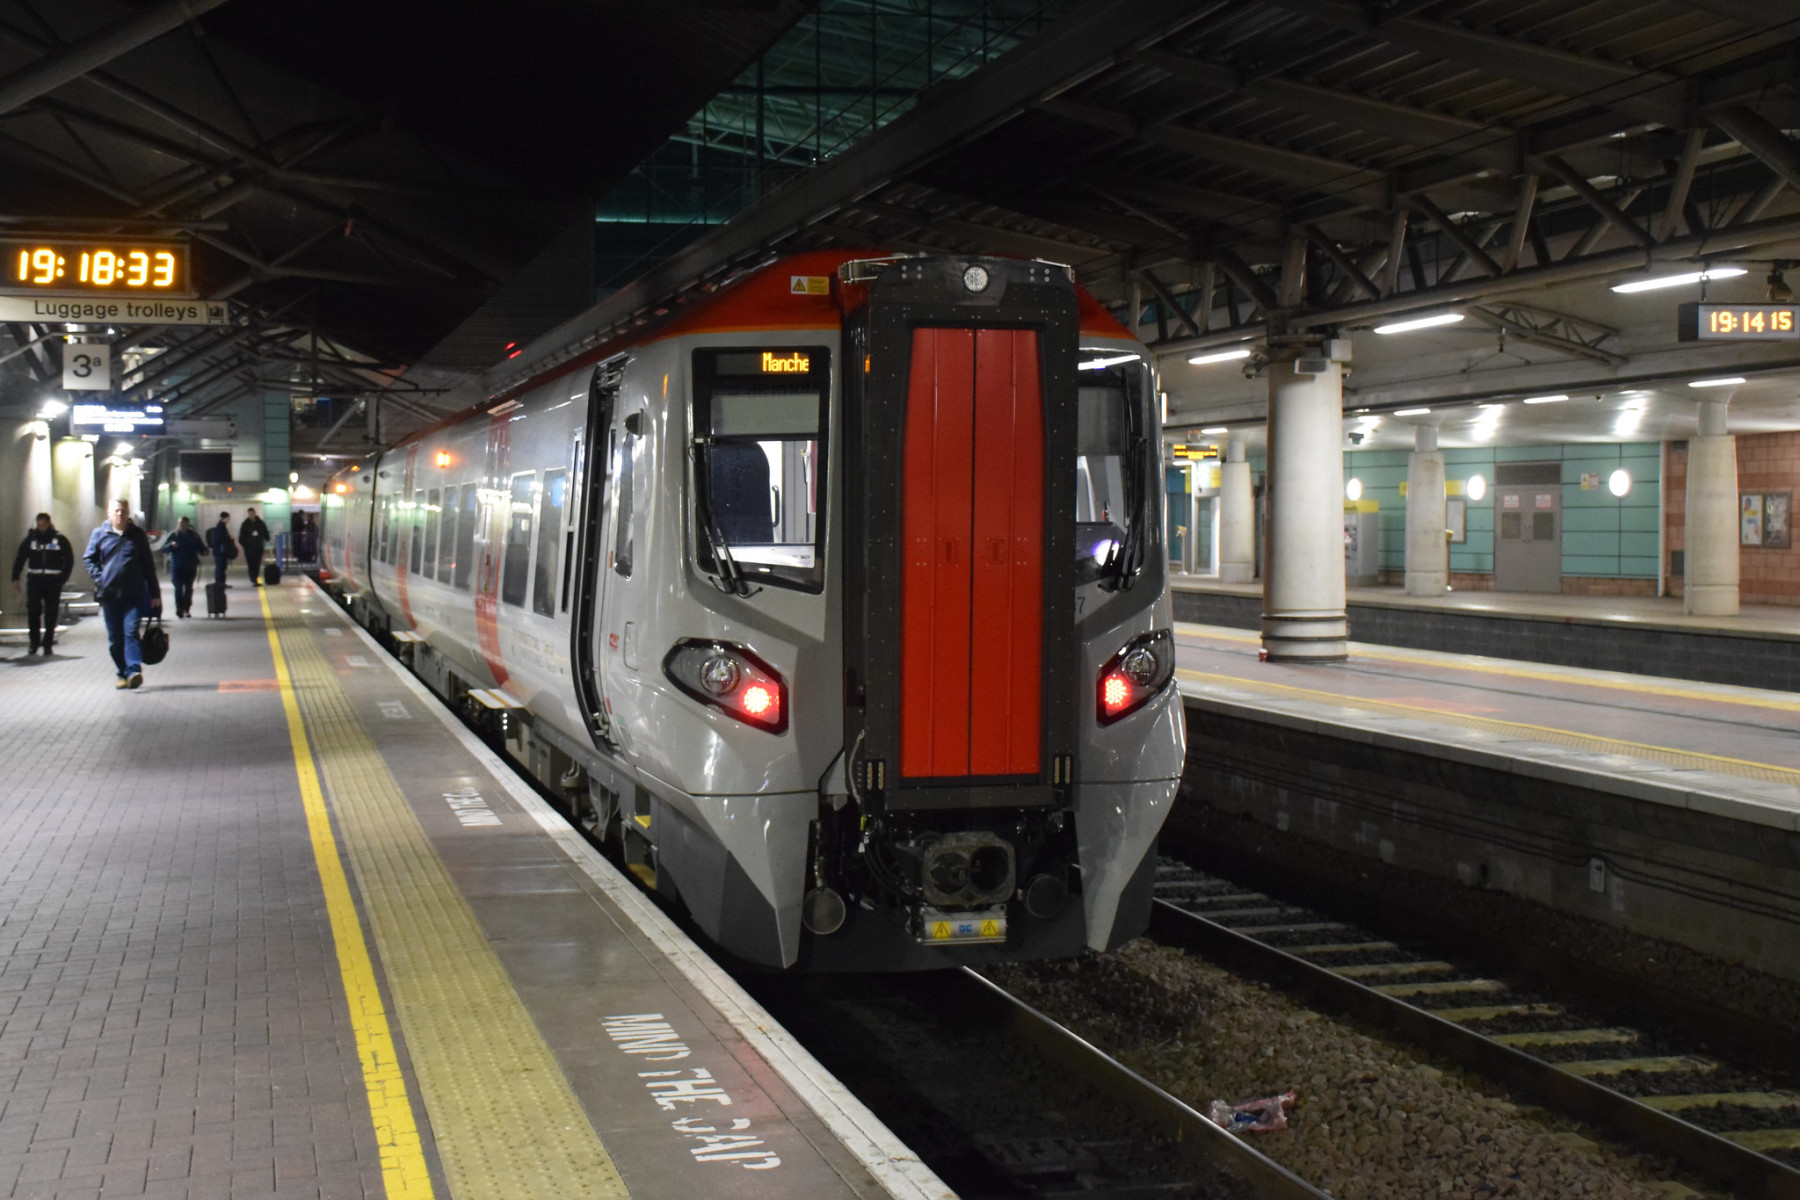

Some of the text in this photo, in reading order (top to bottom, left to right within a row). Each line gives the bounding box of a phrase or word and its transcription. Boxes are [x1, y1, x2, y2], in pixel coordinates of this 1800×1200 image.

[35, 300, 198, 320] Luggage trolleys
[762, 352, 809, 372] Manche
[602, 1013, 691, 1060] MIND
[638, 1067, 732, 1110] THE
